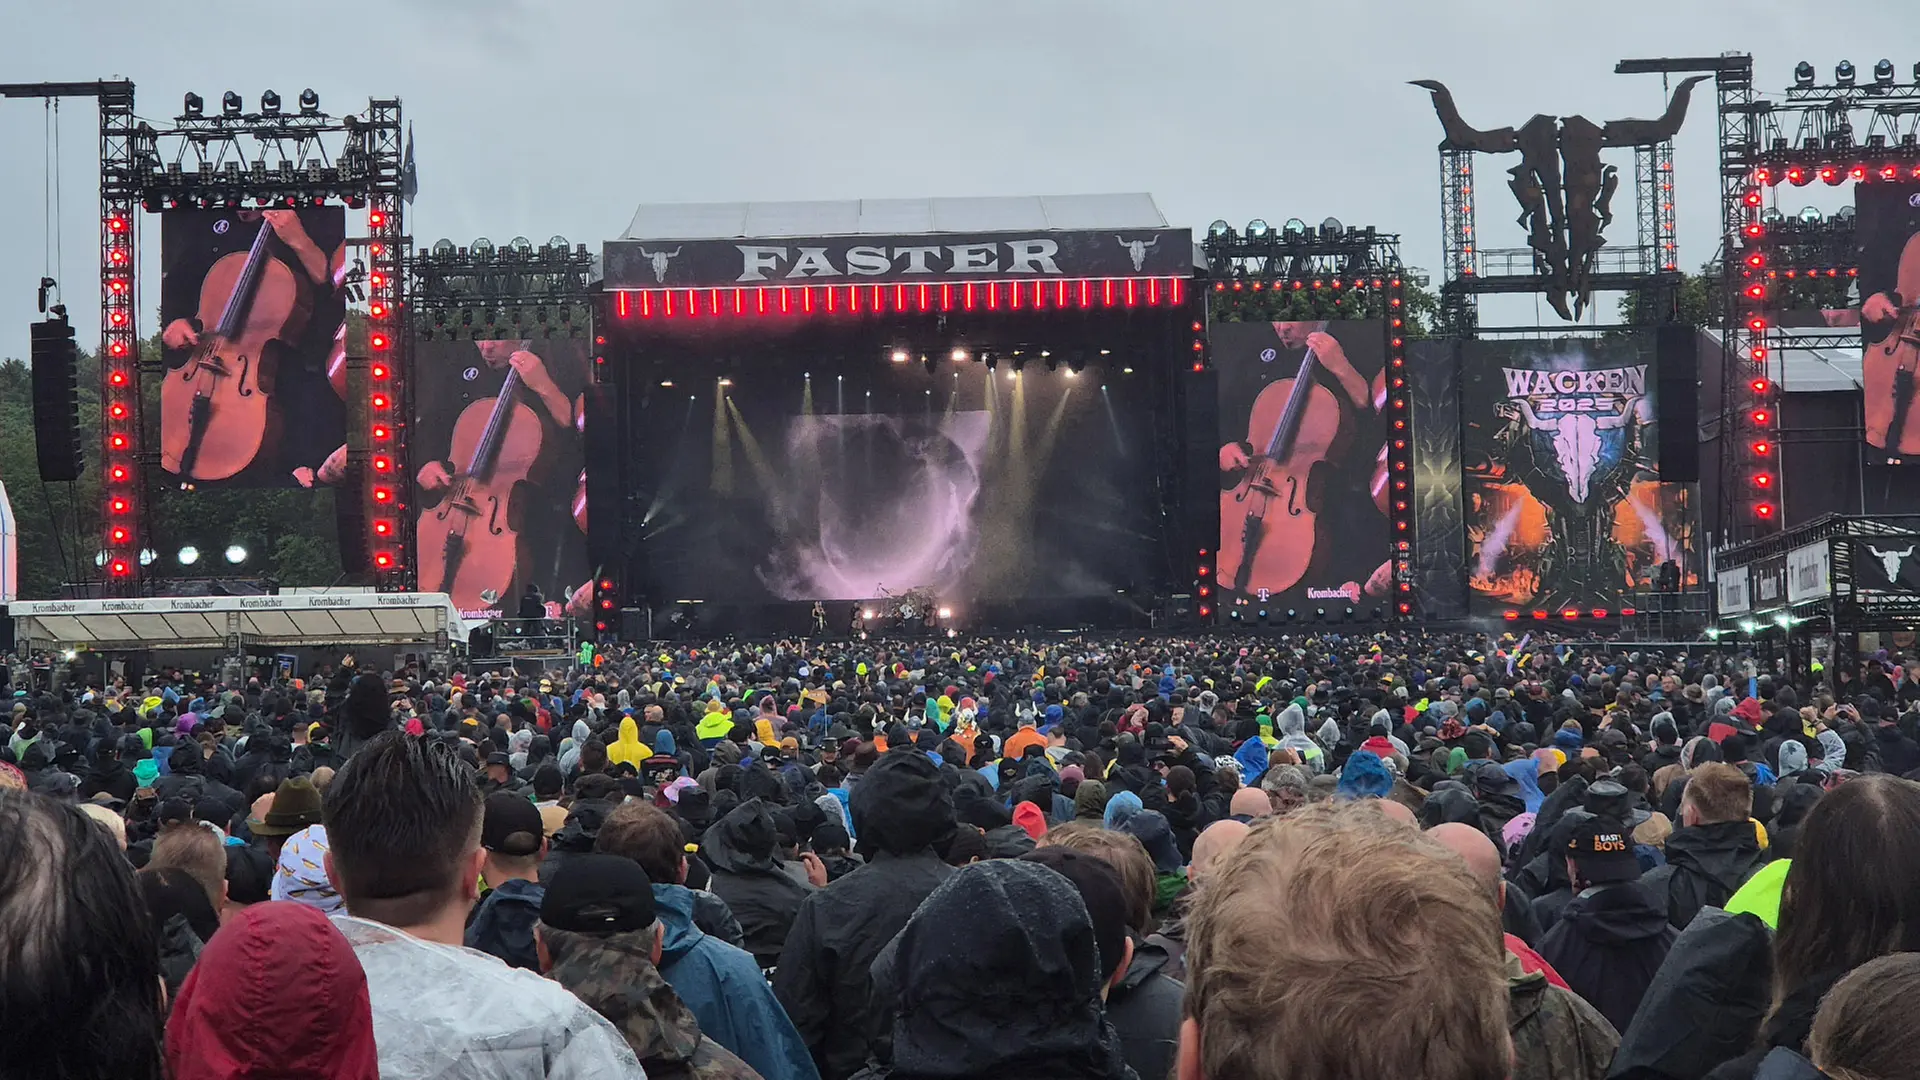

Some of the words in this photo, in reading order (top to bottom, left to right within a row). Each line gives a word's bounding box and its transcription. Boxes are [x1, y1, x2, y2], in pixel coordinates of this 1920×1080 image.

[735, 239, 1063, 282] FASTER
[1502, 364, 1648, 398] WACKEN
[1541, 398, 1613, 412] 2025
[1307, 587, 1352, 599] Krombacher
[171, 599, 214, 611] Krombacher
[240, 597, 283, 609] Krombacher
[309, 595, 352, 607] Krombacher
[377, 594, 420, 606] Krombacher
[32, 603, 76, 613] Krombacher
[102, 601, 145, 612] Krombacher
[1594, 840, 1626, 851] BOYS
